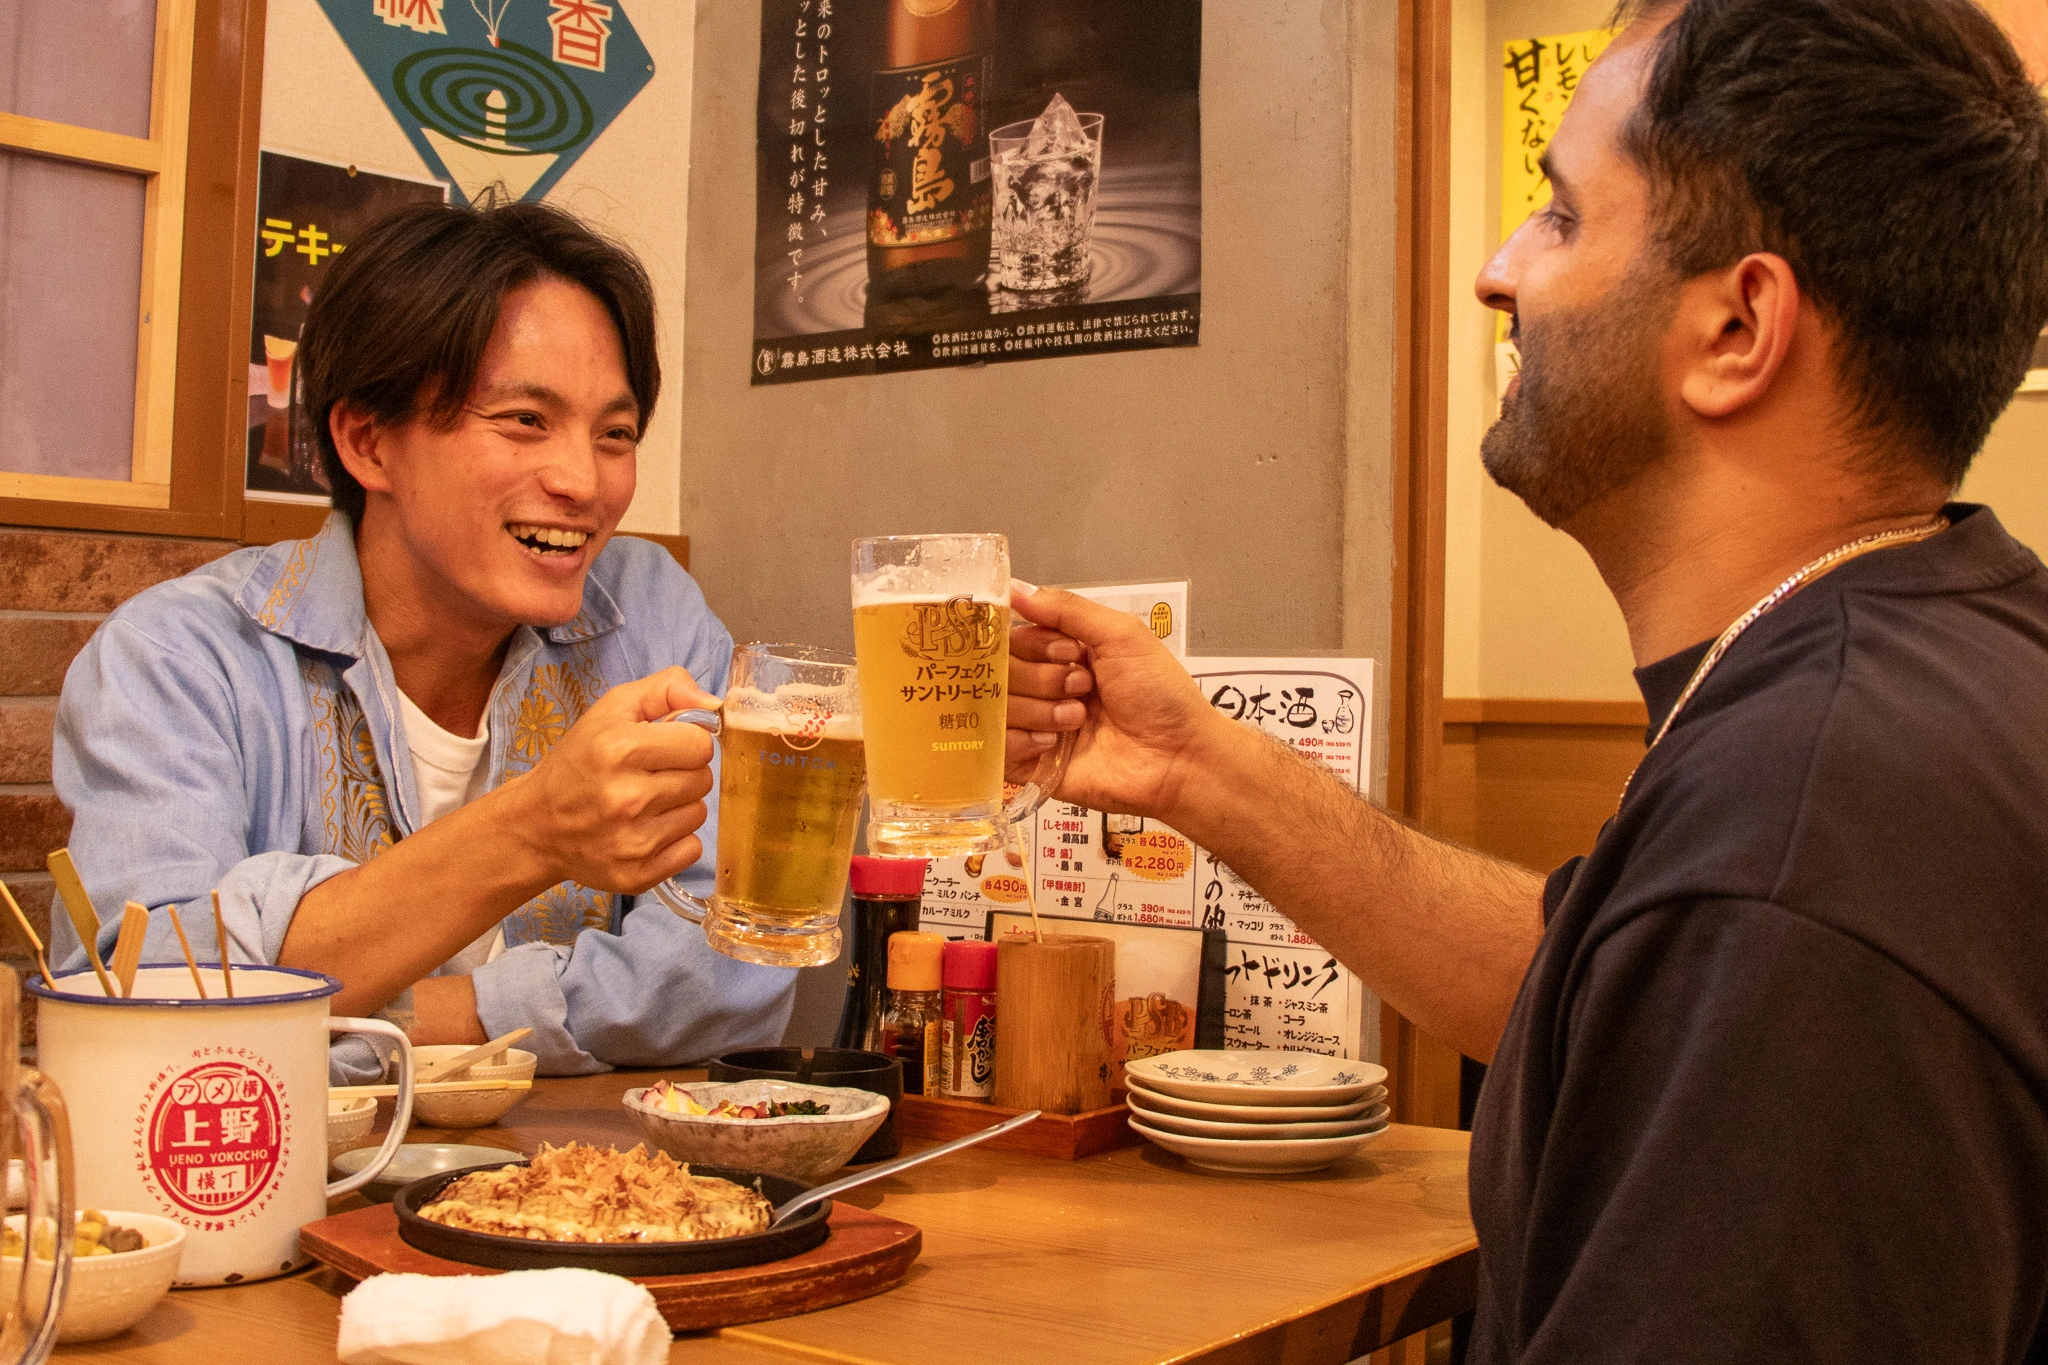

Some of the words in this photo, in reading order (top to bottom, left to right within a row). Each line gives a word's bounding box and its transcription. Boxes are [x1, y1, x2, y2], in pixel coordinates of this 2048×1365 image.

[780, 341, 910, 369] 霧島酒造株式会社
[916, 662, 995, 680] パーフェクト
[901, 682, 1002, 702] サントリービール
[1209, 684, 1318, 728] 日本酒
[938, 711, 979, 730] 糖質0
[931, 740, 985, 752] SUNTORY
[1298, 737, 1324, 747] 490円
[759, 750, 837, 770] TONTON
[1061, 806, 1089, 818] 二階堂
[1043, 819, 1084, 833] 【しそ焼酎】
[1120, 837, 1136, 845] グラス
[1106, 858, 1122, 866] ボトル
[1041, 878, 1086, 893] 【甲類焼酎】
[937, 889, 957, 899] ミルク
[960, 891, 981, 901] パンチ
[1238, 890, 1264, 901] テキー
[922, 906, 971, 918] カルーアミルク
[1117, 903, 1133, 911] グラス
[1141, 903, 1165, 913] 390円
[1237, 920, 1264, 931] マッコリ
[1284, 998, 1329, 1014] ジャスミン茶
[1283, 1014, 1306, 1026] コーラ
[1283, 1029, 1341, 1046] オレンジジュース
[176, 1080, 259, 1101] アメ横
[170, 1106, 260, 1147] 上野
[169, 1153, 204, 1167] UENO
[209, 1148, 268, 1163] YOKOCHO
[196, 1170, 240, 1191] 横丁
